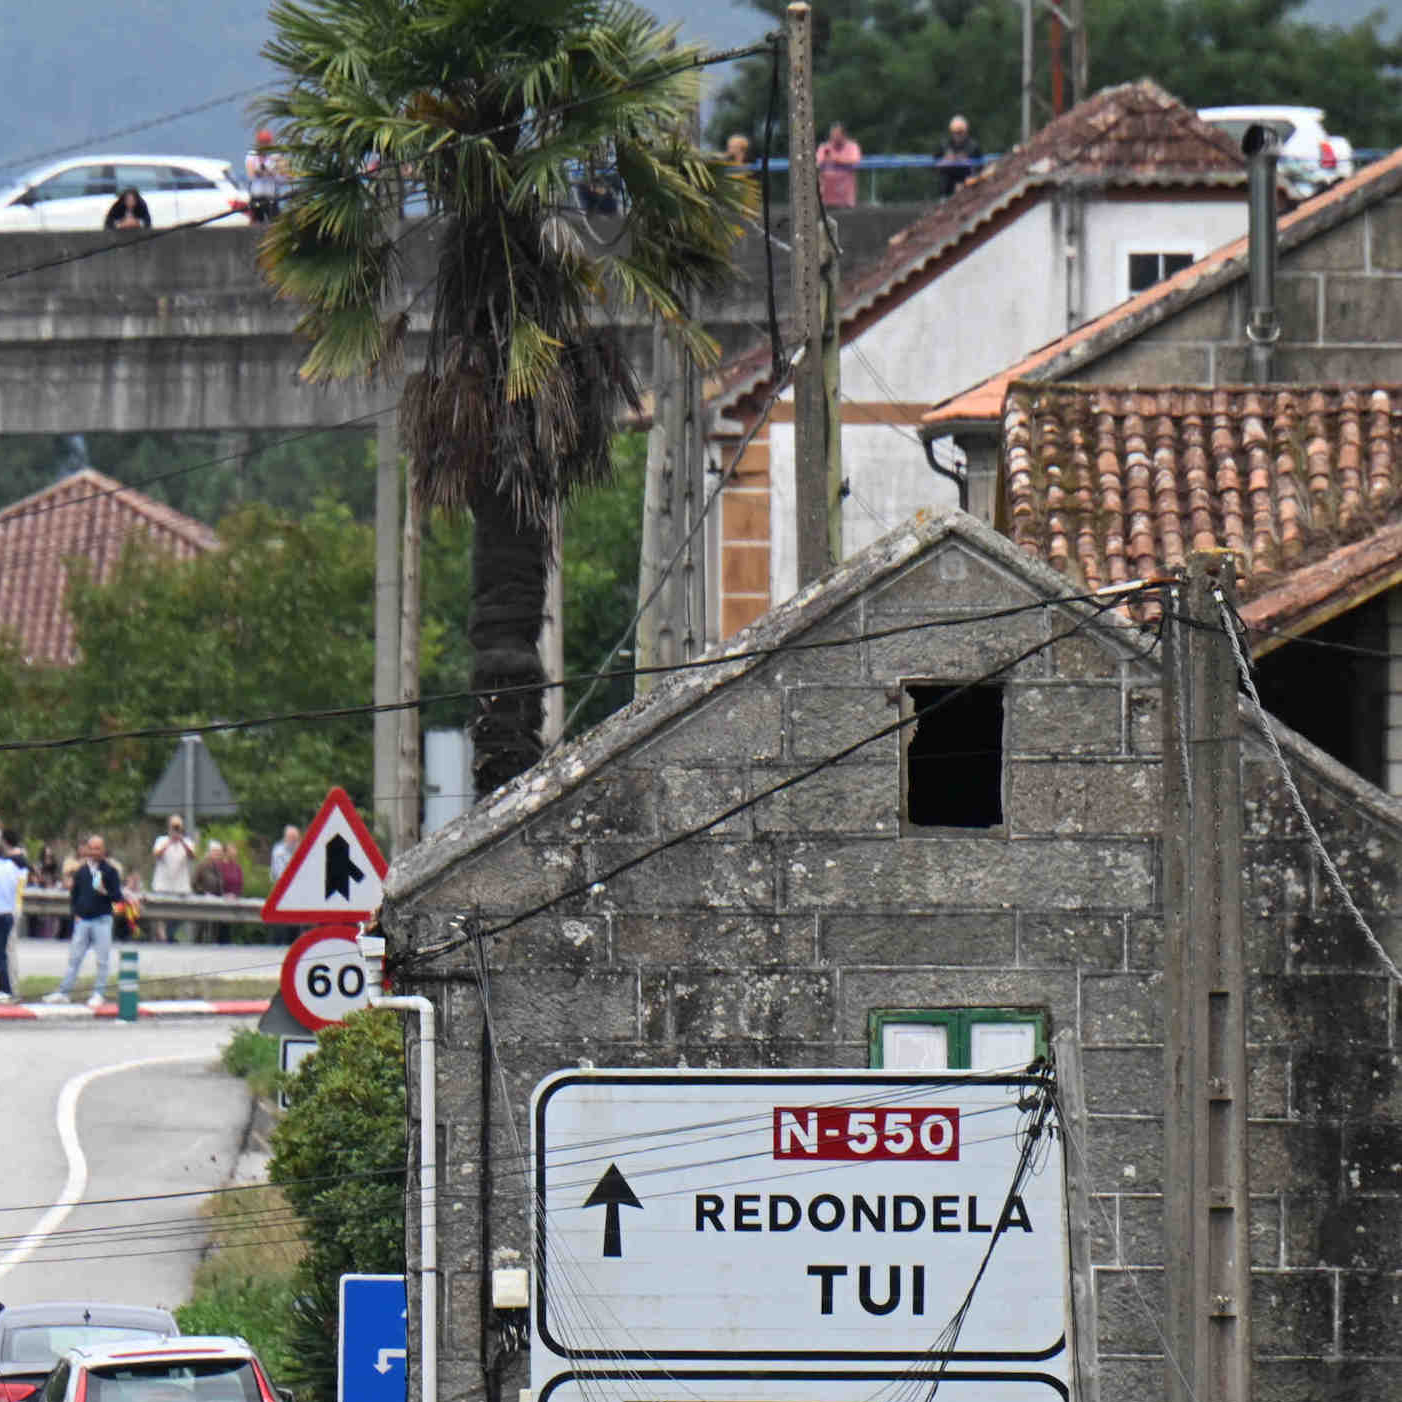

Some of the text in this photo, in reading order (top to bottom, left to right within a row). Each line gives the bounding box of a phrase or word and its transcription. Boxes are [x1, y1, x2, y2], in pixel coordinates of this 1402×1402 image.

[307, 964, 365, 998] 60
[780, 1112, 954, 1155] N-550
[695, 1194, 1034, 1233] REDONDELA
[807, 1265, 925, 1316] TUI
